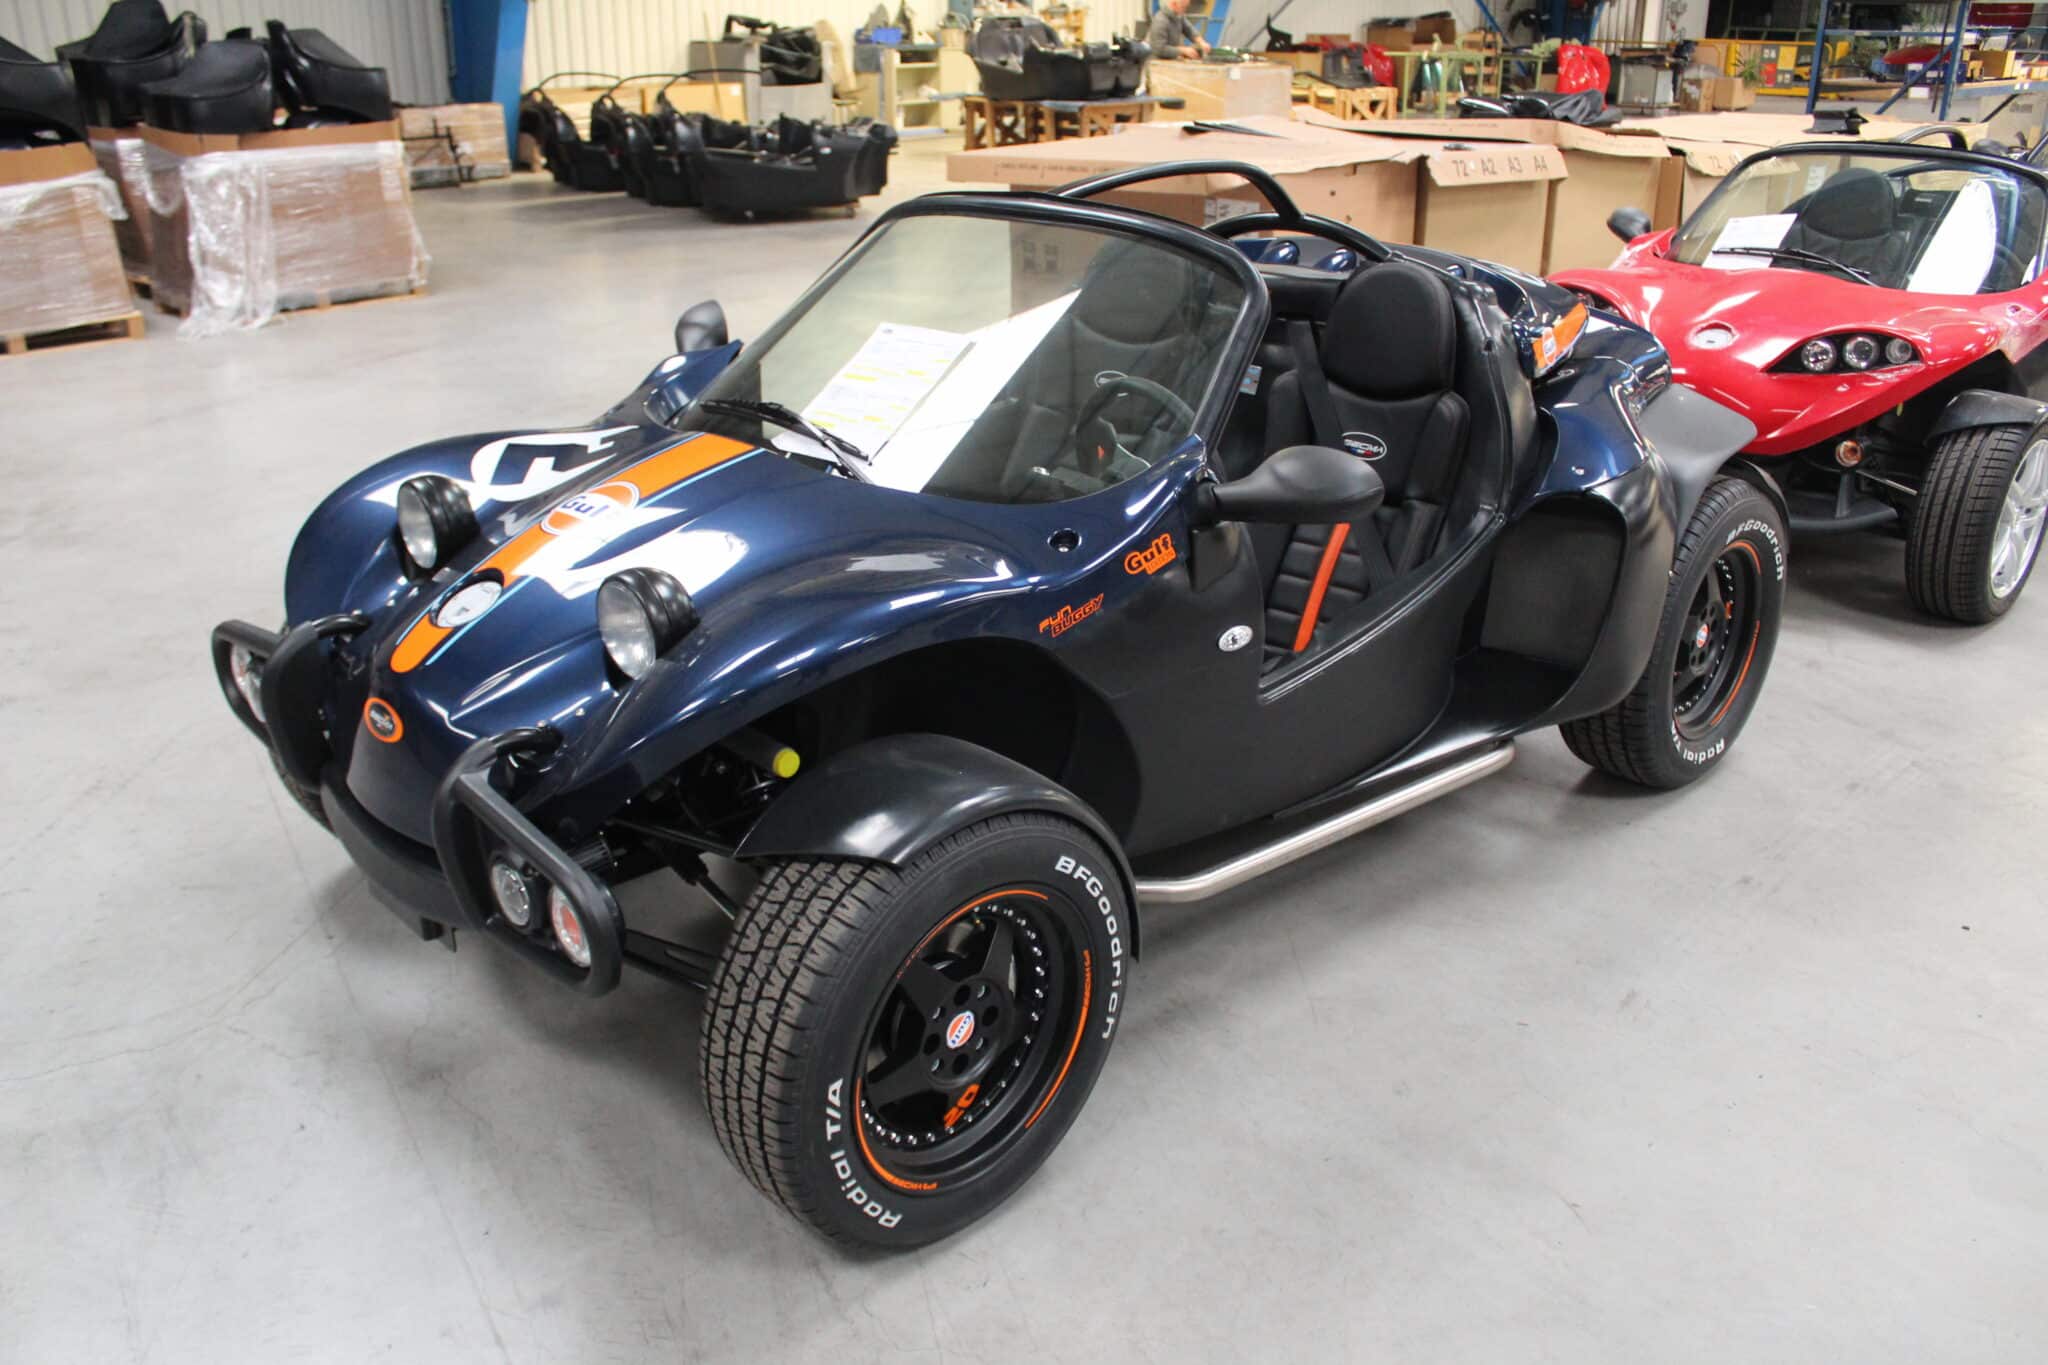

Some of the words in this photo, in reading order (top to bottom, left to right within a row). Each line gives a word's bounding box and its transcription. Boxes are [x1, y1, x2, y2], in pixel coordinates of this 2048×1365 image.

[1124, 533, 1172, 574] Gulf
[1051, 592, 1104, 638] BUGGY
[1054, 855, 1123, 1040] BFGoodrich
[825, 1078, 844, 1141] T/A
[829, 1149, 903, 1229] Radial
